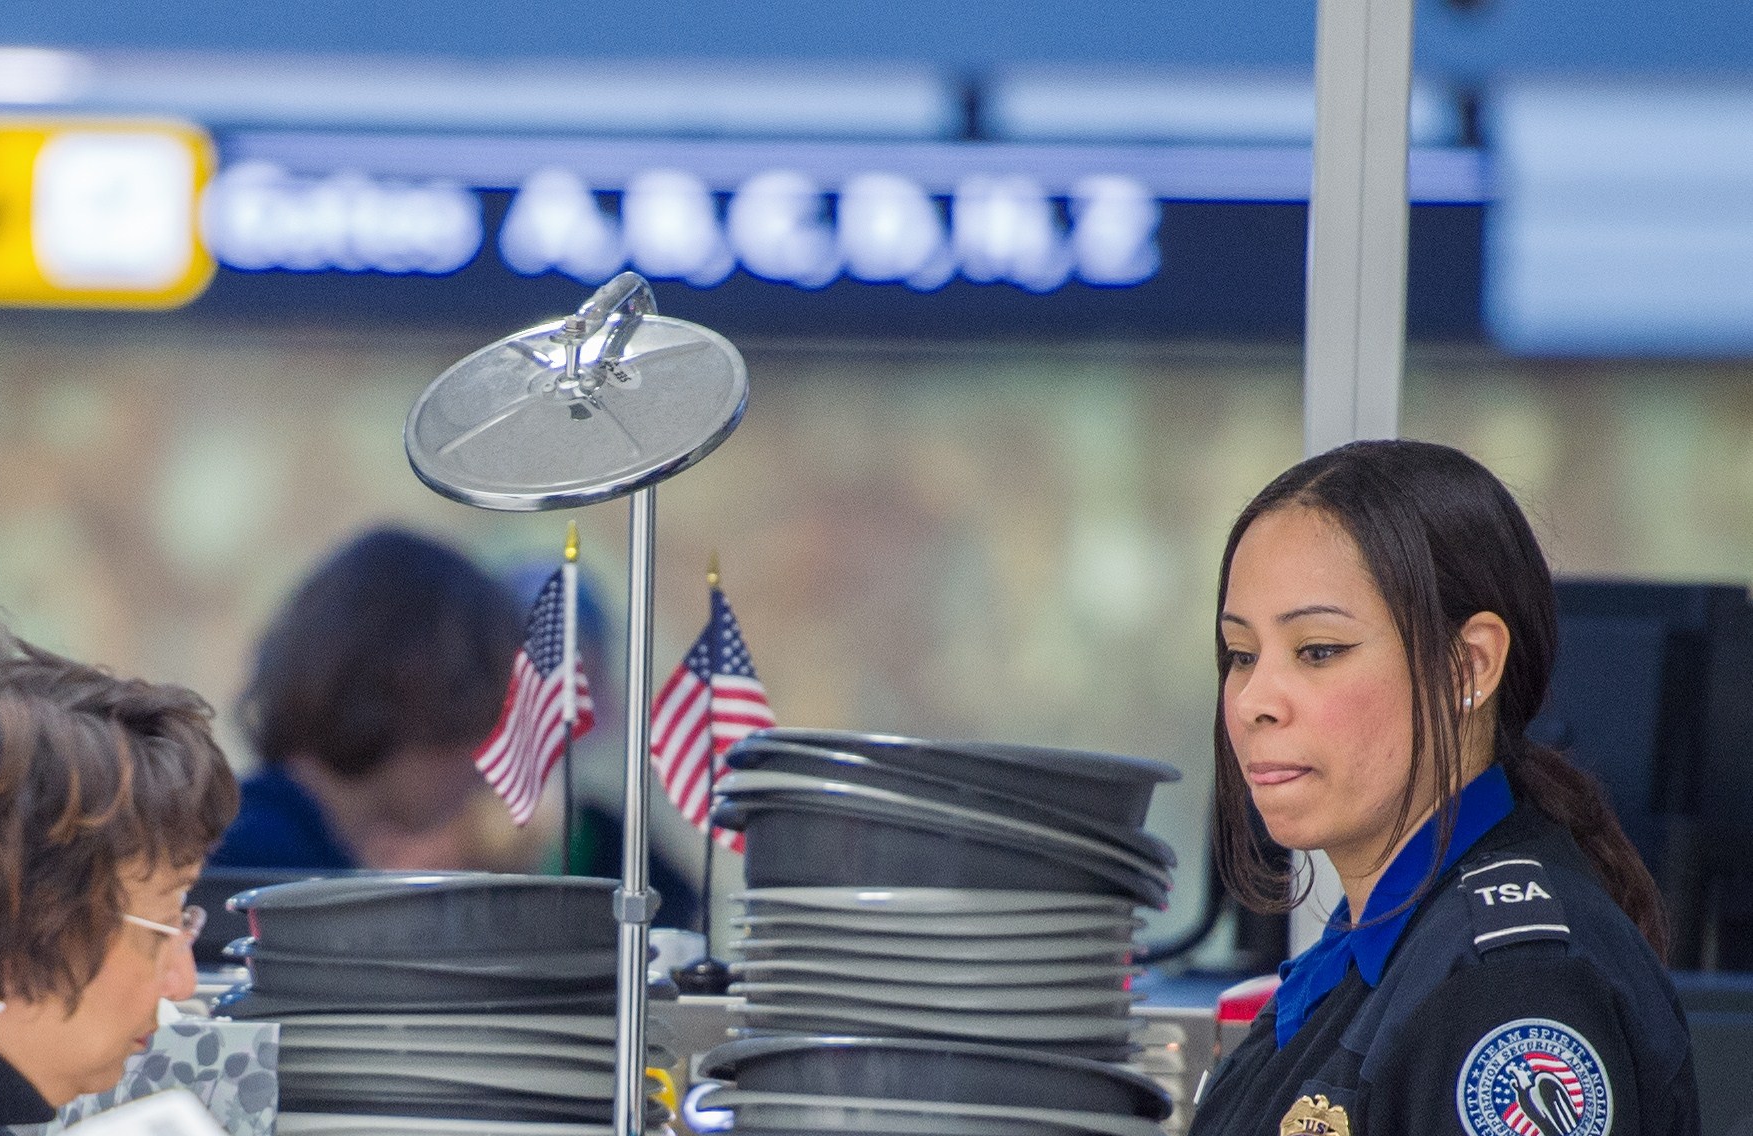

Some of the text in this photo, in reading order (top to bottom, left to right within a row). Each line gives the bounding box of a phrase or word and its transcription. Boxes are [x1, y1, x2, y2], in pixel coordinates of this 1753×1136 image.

[1474, 881, 1552, 906] TSA
[1478, 1028, 1588, 1066] TEAM SPIRIT
[1501, 1041, 1567, 1062] SECURITY
